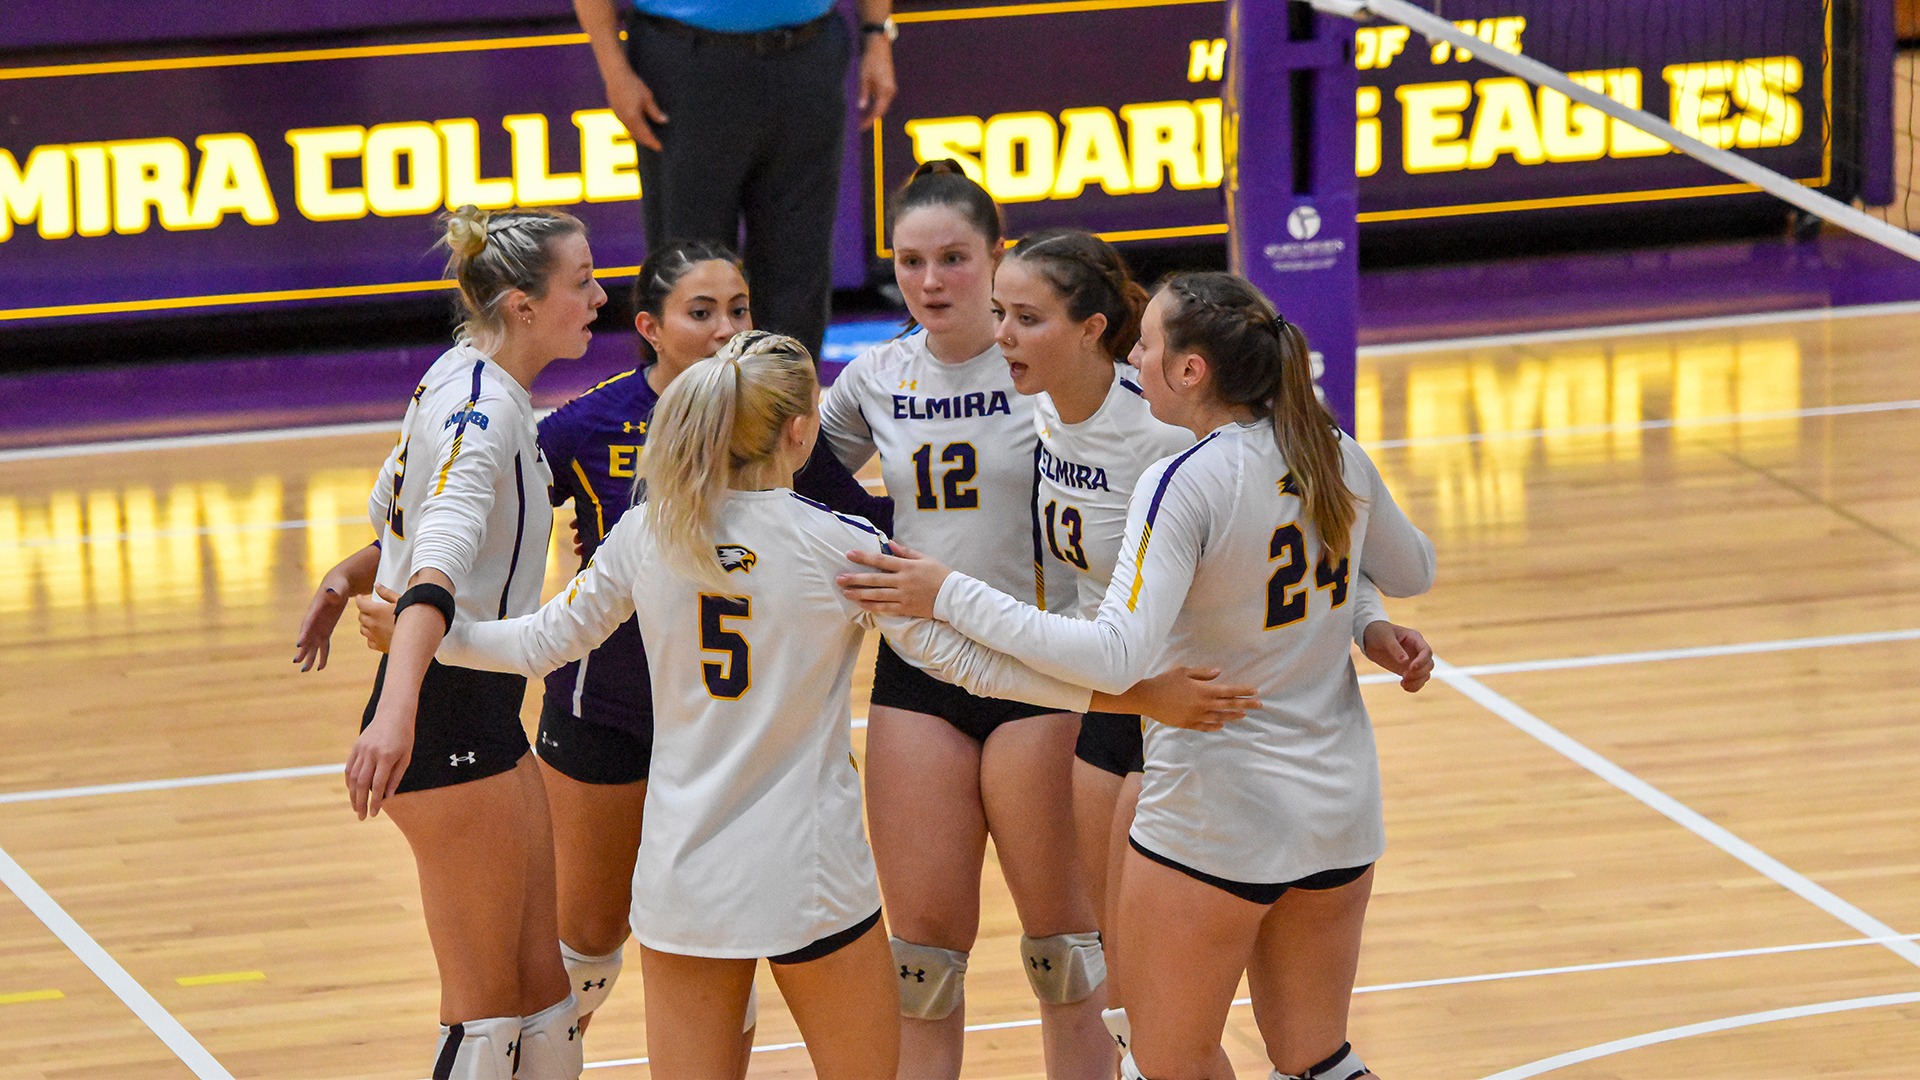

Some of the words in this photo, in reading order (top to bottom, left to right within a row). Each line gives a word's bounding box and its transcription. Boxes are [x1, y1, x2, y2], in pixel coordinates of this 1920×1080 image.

[1395, 56, 1803, 174] EAGLES
[892, 390, 1011, 420] ELMIRA
[912, 441, 981, 511] 12
[1038, 446, 1110, 492] ELMIRA
[1044, 500, 1089, 572] 13
[1263, 520, 1351, 631] 24
[698, 591, 752, 701] 5
